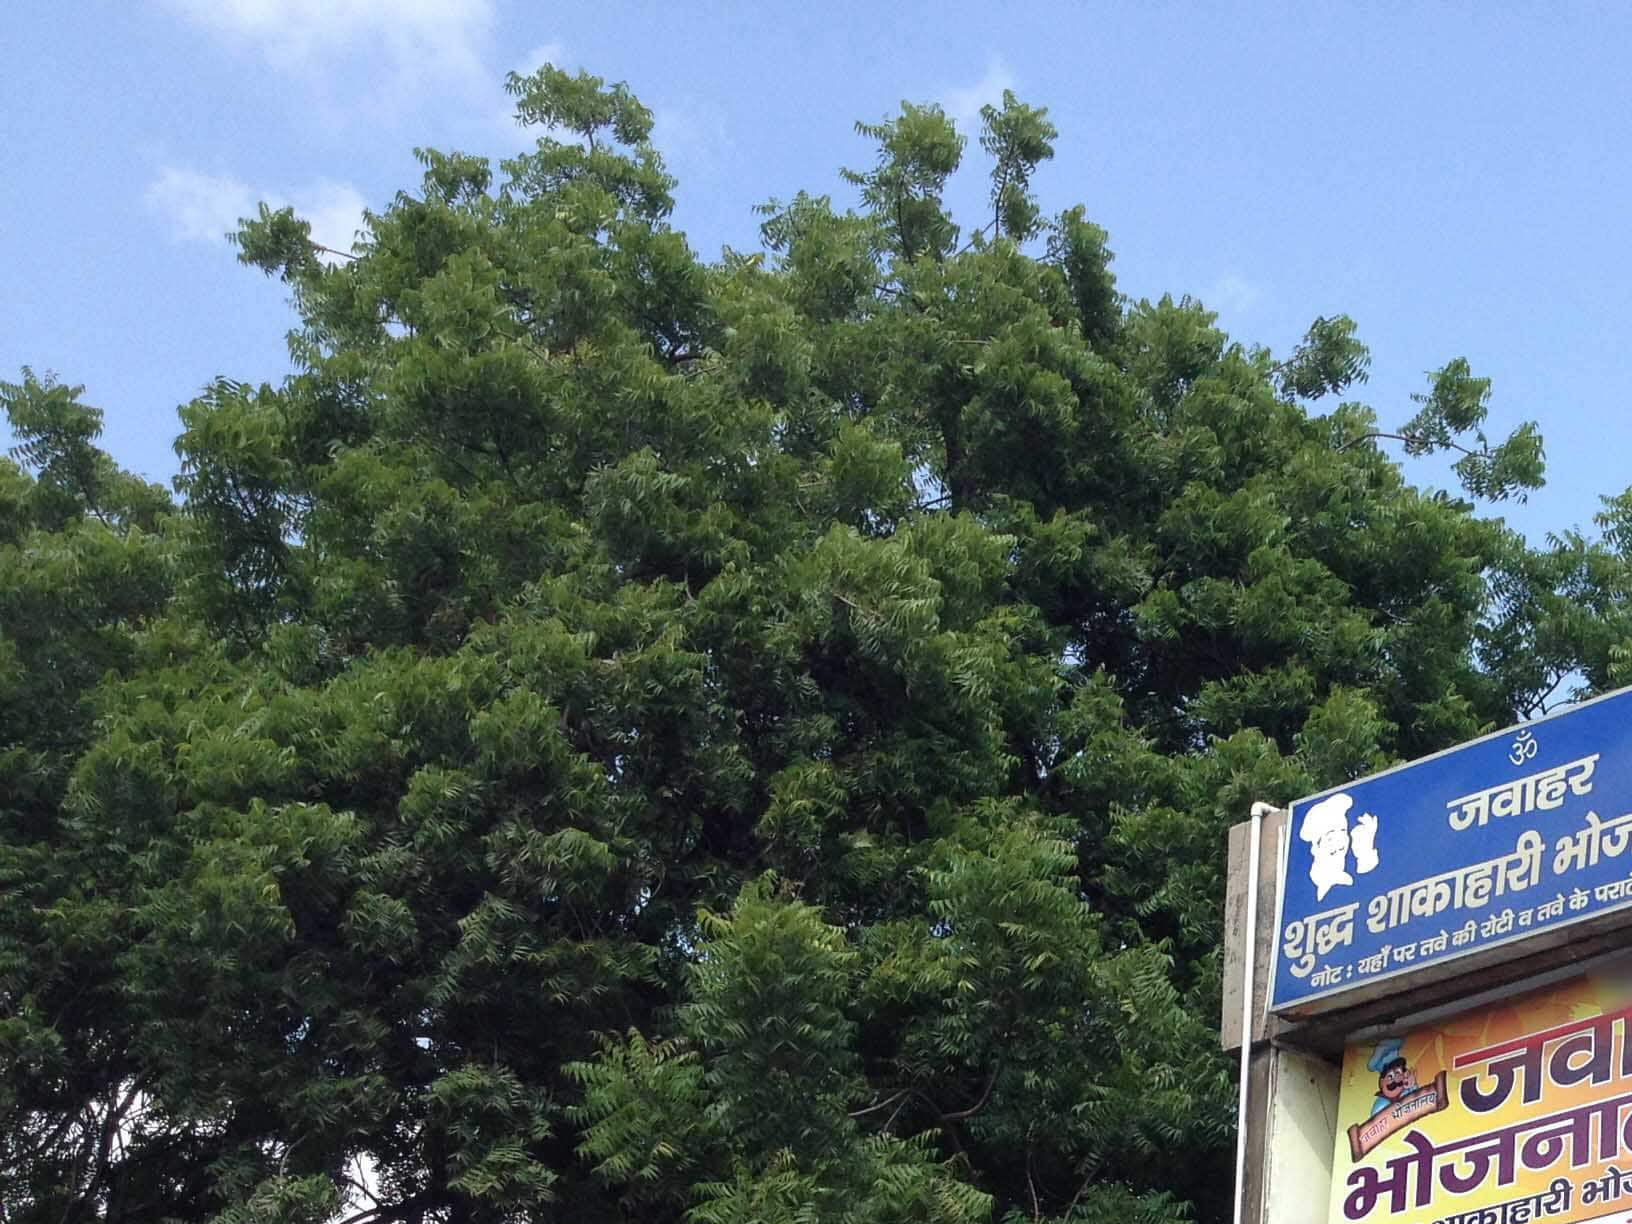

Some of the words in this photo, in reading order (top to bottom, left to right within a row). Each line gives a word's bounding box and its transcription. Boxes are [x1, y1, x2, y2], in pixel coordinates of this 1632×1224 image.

[1447, 754, 1599, 832] जवाहर
[1283, 902, 1359, 977] शुद्ध
[1366, 830, 1546, 934] शाकाहारी
[1393, 943, 1417, 963] पर
[1420, 929, 1448, 957] तवे
[1452, 923, 1478, 947] की
[1480, 909, 1515, 939] रोटी
[1518, 909, 1534, 928] व
[1537, 894, 1566, 921] तवे
[1569, 887, 1590, 911] के
